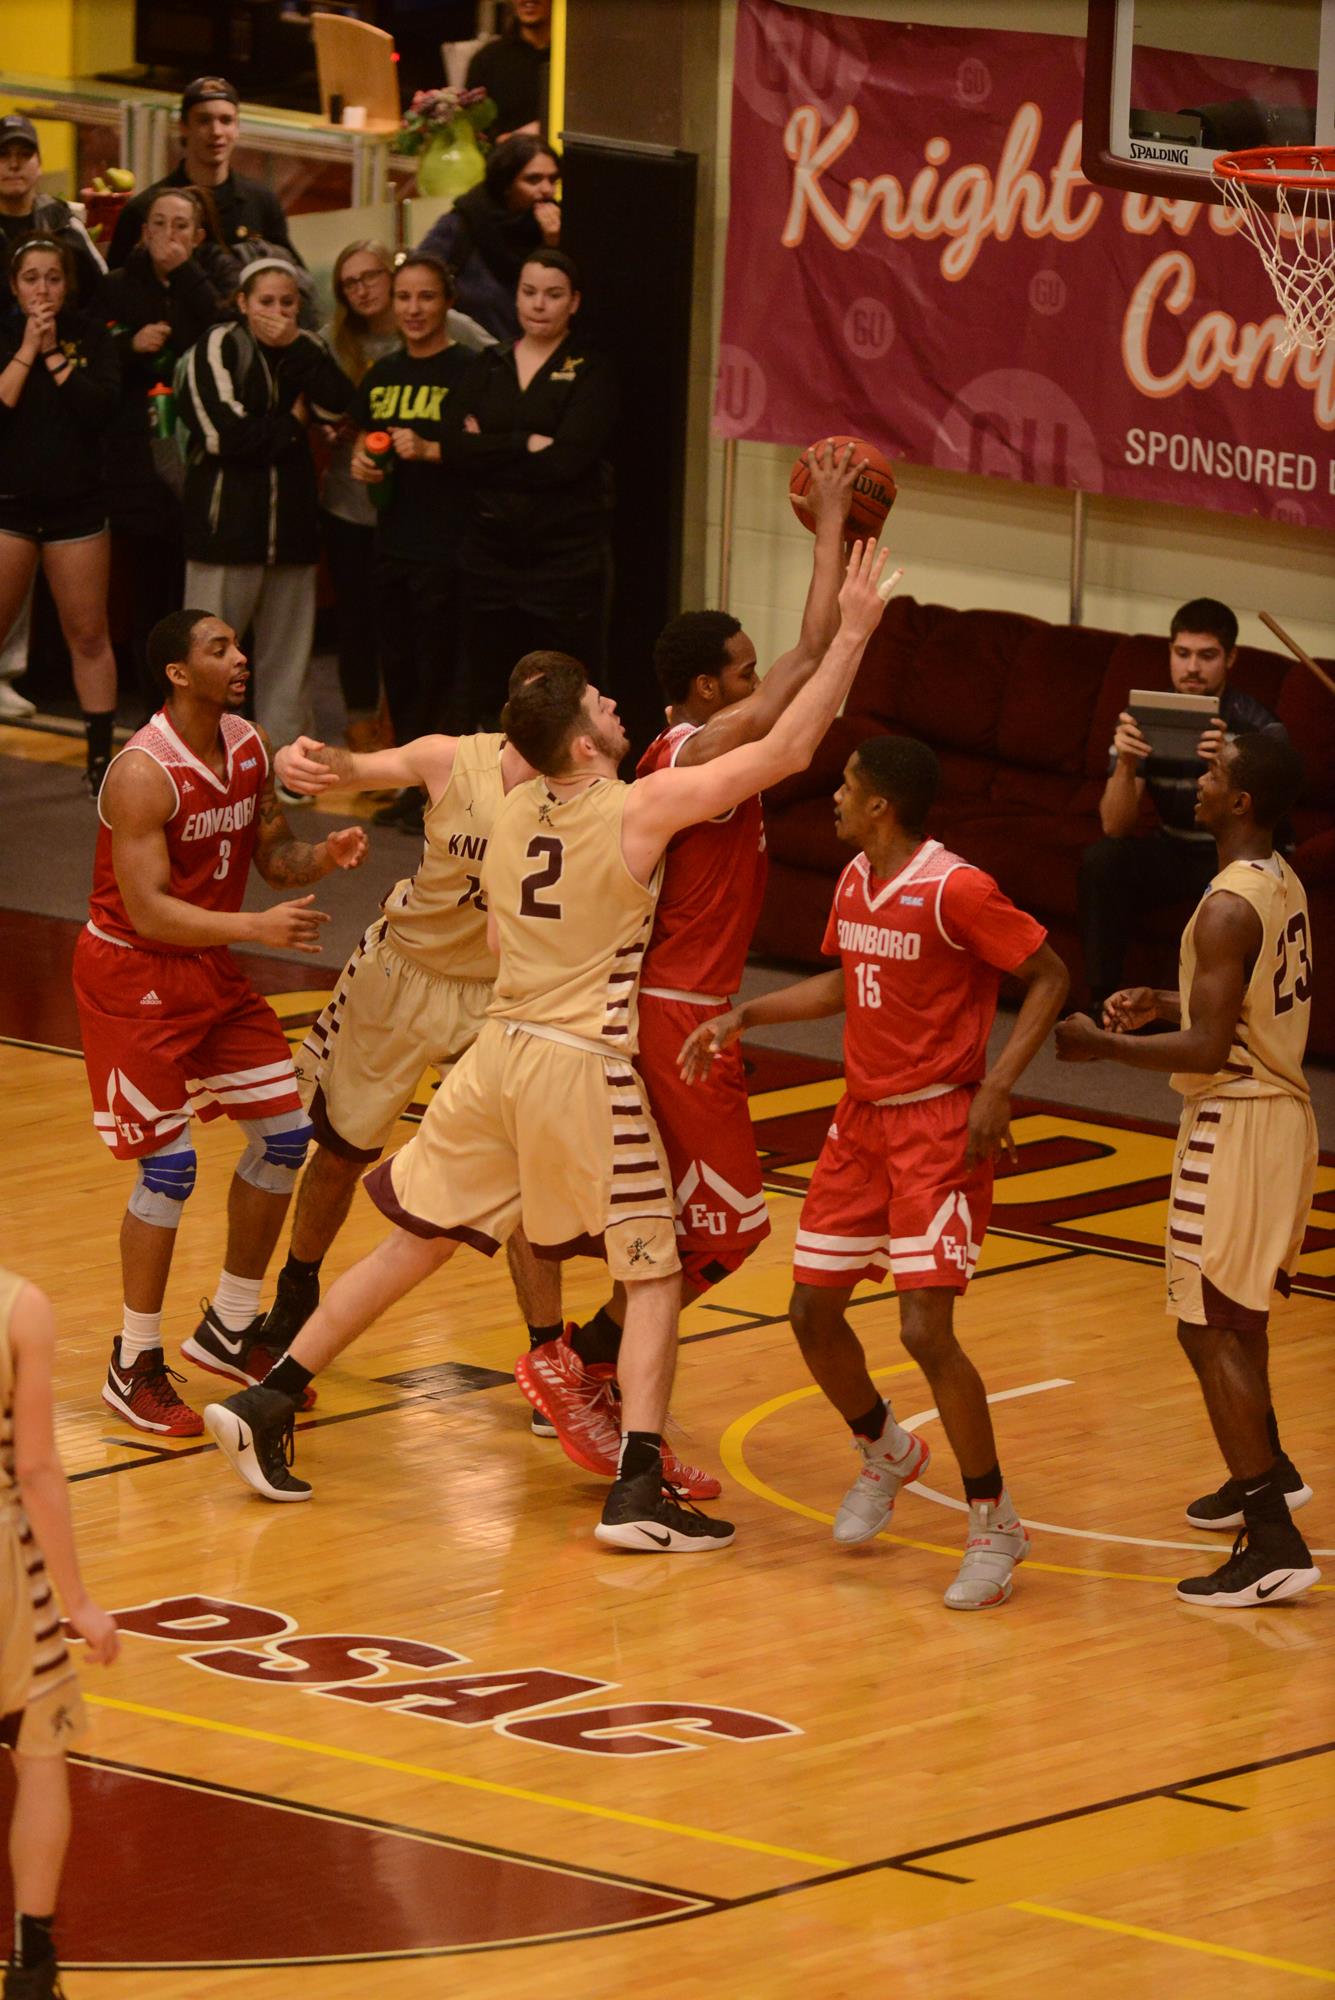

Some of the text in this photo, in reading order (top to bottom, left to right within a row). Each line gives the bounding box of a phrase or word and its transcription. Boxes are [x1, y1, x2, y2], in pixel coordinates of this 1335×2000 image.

[1130, 143, 1188, 165] SPALDING
[781, 103, 1102, 282] Knight
[853, 309, 886, 348] GU
[1124, 428, 1317, 491] SPONSORED
[213, 839, 232, 880] 3
[449, 834, 488, 861] KNI
[519, 834, 564, 920] 2
[1273, 911, 1312, 1017] 23
[855, 962, 882, 1009] 15
[689, 1203, 727, 1235] EU
[941, 1235, 967, 1270] EU
